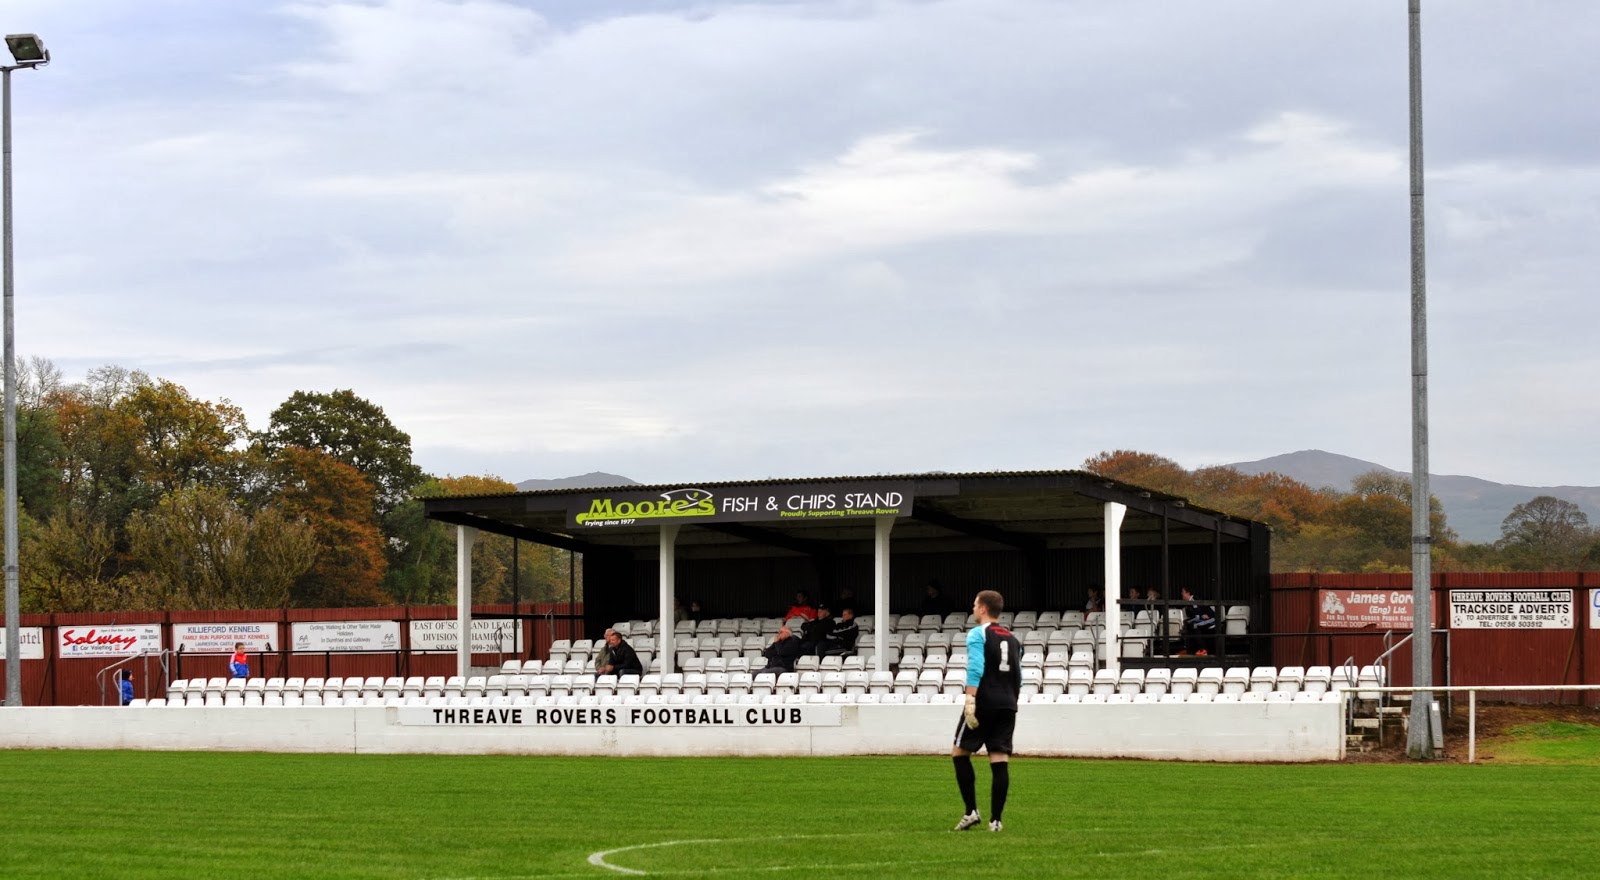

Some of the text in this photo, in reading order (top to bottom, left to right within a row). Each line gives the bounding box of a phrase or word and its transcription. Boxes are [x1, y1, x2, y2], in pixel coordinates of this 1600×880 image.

[586, 492, 715, 518] Moore's
[722, 492, 903, 512] FISH & CHIPS STAND
[780, 510, 806, 518] Proudly
[808, 509, 845, 518] Supporting
[846, 508, 874, 516] Threave
[1347, 591, 1386, 604] James
[1452, 592, 1570, 602] THREAVE ROVERS FOOTBALL CLUB
[1369, 605, 1407, 615] (Eng) Ltd.
[1454, 604, 1569, 614] TRACKSIDE ADVERTS
[187, 625, 261, 634] KILLIEFORD KENNELS
[414, 621, 434, 630] EAST
[435, 621, 445, 630] OF
[448, 621, 489, 630] SCAND
[63, 629, 137, 650] Solway
[423, 632, 514, 641] DIVISION HAMPIONS
[471, 643, 501, 652] 999-200
[999, 640, 1010, 672] 1
[433, 708, 802, 724] THREAVE ROVERS FOOTBALL CLUB
